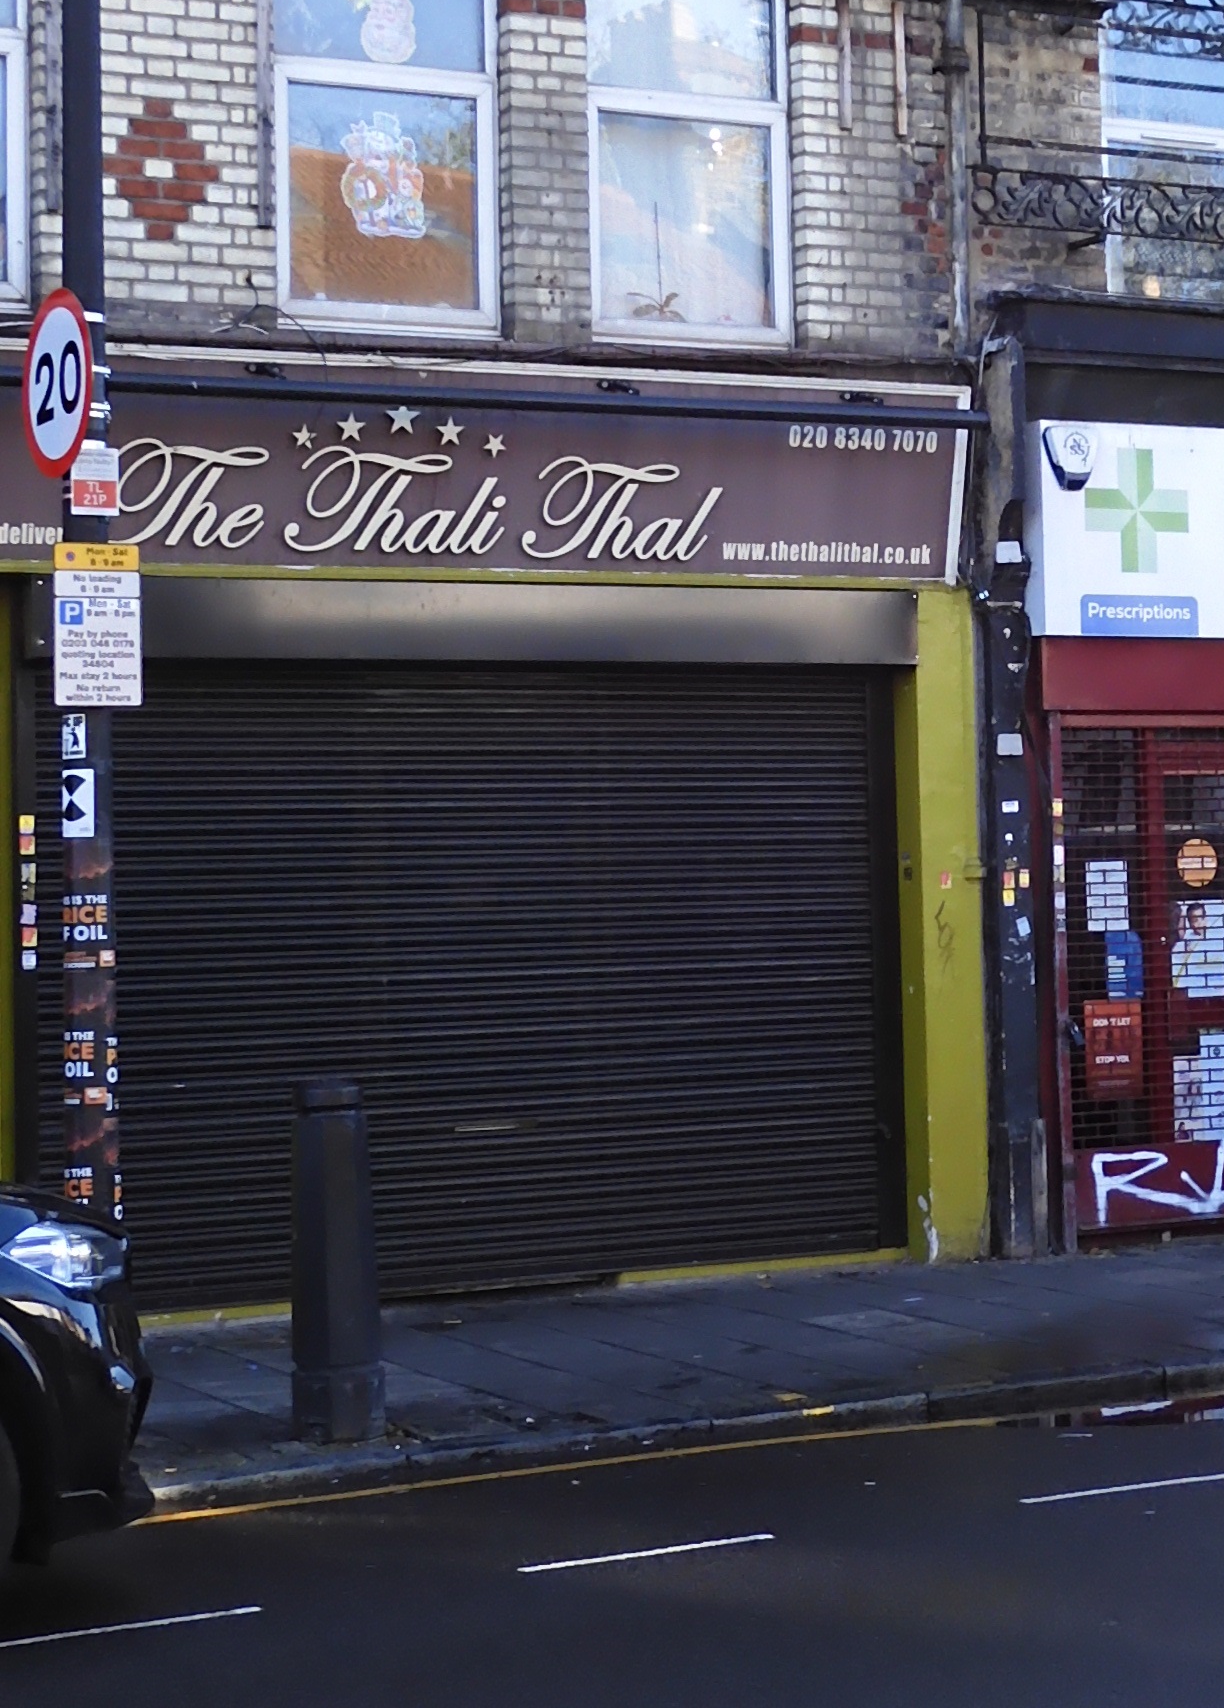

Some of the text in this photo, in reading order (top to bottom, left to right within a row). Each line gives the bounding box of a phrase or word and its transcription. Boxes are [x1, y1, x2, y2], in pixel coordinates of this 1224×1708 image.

[36, 340, 81, 426] 20
[789, 425, 938, 453] 020 8340 7070
[86, 481, 104, 493] TL
[83, 494, 107, 505] 21P
[107, 438, 724, 561] The Thali Thal
[722, 541, 931, 565] www.thethalithal.co.uk
[65, 603, 80, 623] P
[1088, 602, 1191, 623] Prescriptions
[68, 630, 128, 639] Pay by phone
[85, 895, 107, 904] THE
[73, 925, 108, 941] OIL
[65, 1061, 94, 1077] OIL
